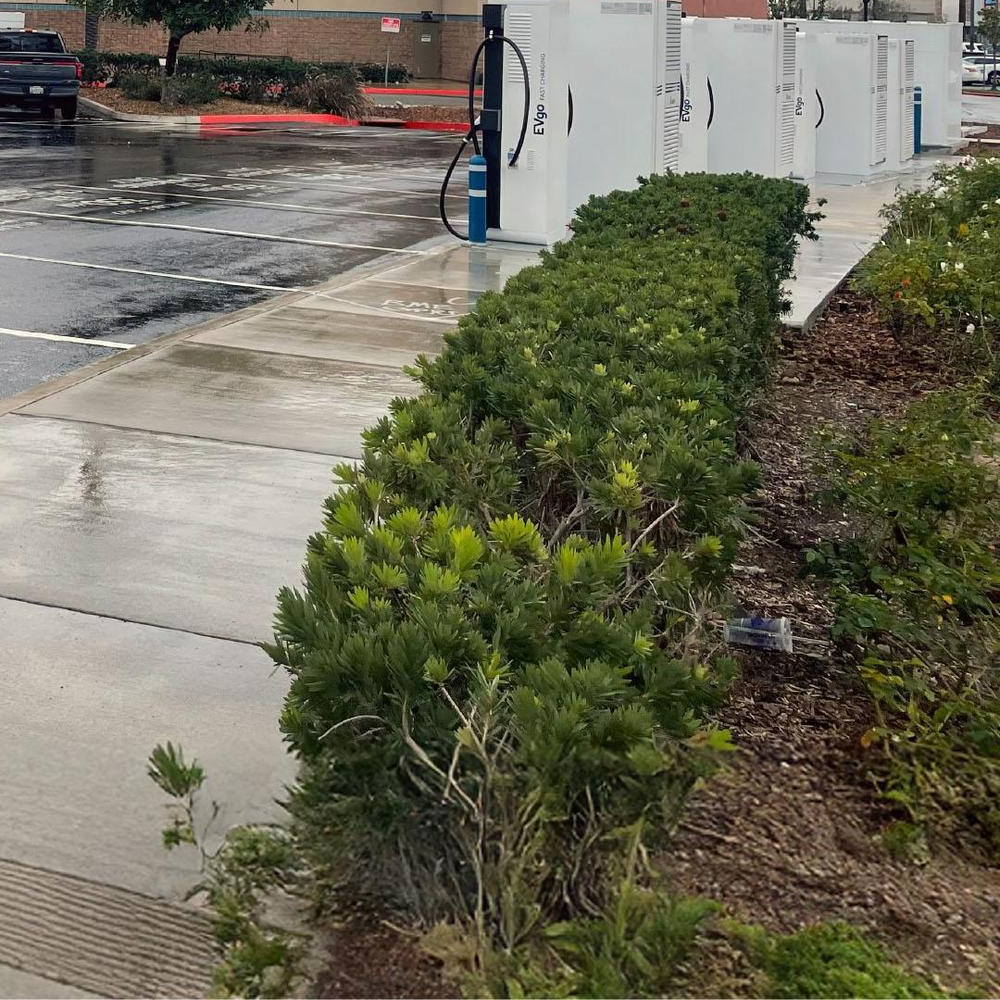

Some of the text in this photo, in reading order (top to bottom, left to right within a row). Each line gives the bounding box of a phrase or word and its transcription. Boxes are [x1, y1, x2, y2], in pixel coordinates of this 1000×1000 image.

[681, 99, 693, 122] EVgo
[795, 96, 804, 116] EVgo
[533, 104, 547, 136] EVgo
